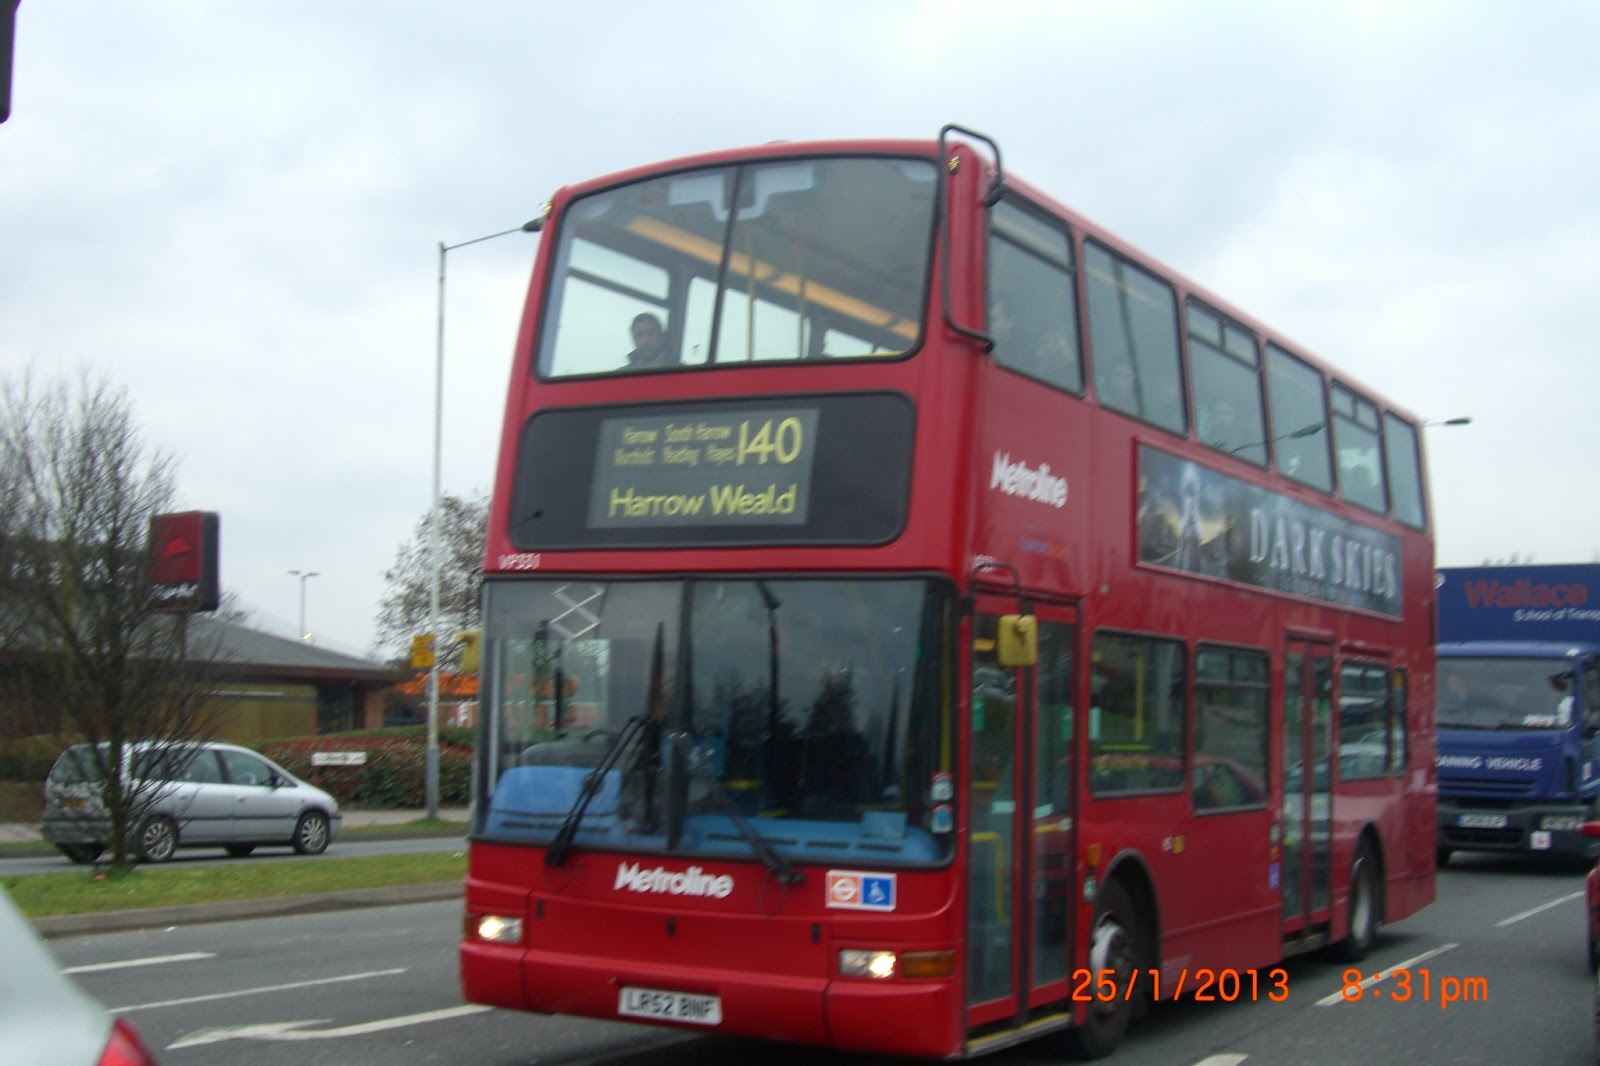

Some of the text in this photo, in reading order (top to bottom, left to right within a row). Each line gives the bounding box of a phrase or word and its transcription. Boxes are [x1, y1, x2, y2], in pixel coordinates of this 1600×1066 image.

[736, 417, 802, 466] 140
[990, 449, 1068, 508] Metroline
[608, 482, 798, 518] Harrow Weald
[1249, 507, 1397, 599] DARK SKIES
[1464, 578, 1590, 609] Wallace
[1485, 756, 1543, 771] VEHICLE
[614, 861, 734, 898] Metroline
